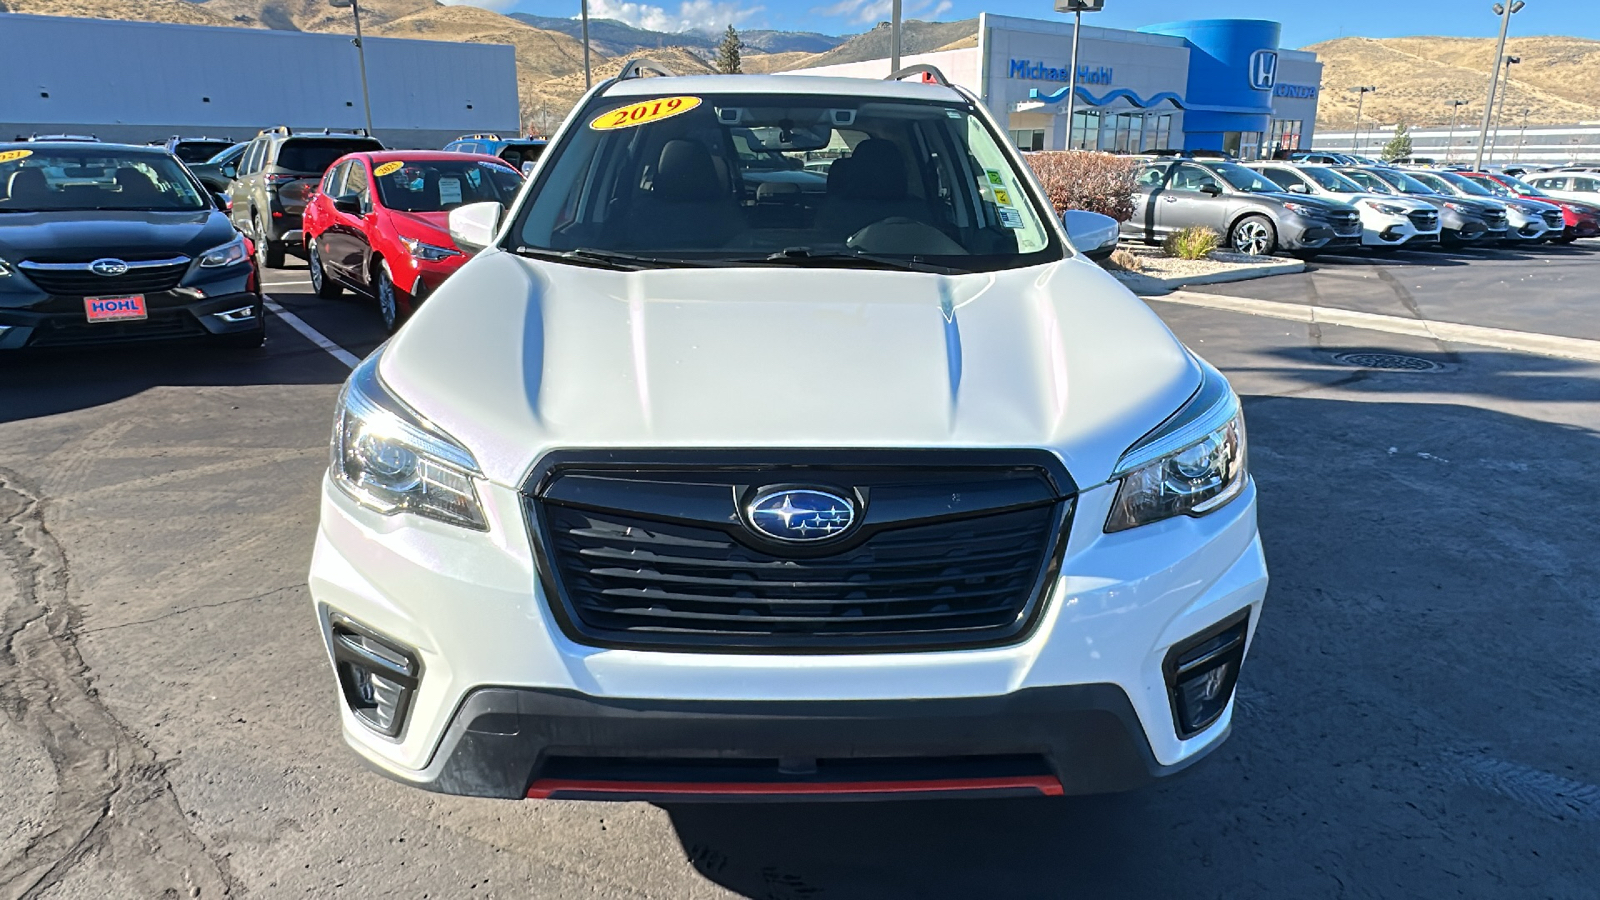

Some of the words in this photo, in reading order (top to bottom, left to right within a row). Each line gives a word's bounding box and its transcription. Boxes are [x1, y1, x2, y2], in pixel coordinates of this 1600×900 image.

[1008, 59, 1072, 82] Michael
[1076, 65, 1113, 84] Hohl
[611, 98, 682, 126] 2019
[92, 299, 140, 312] HOHL
